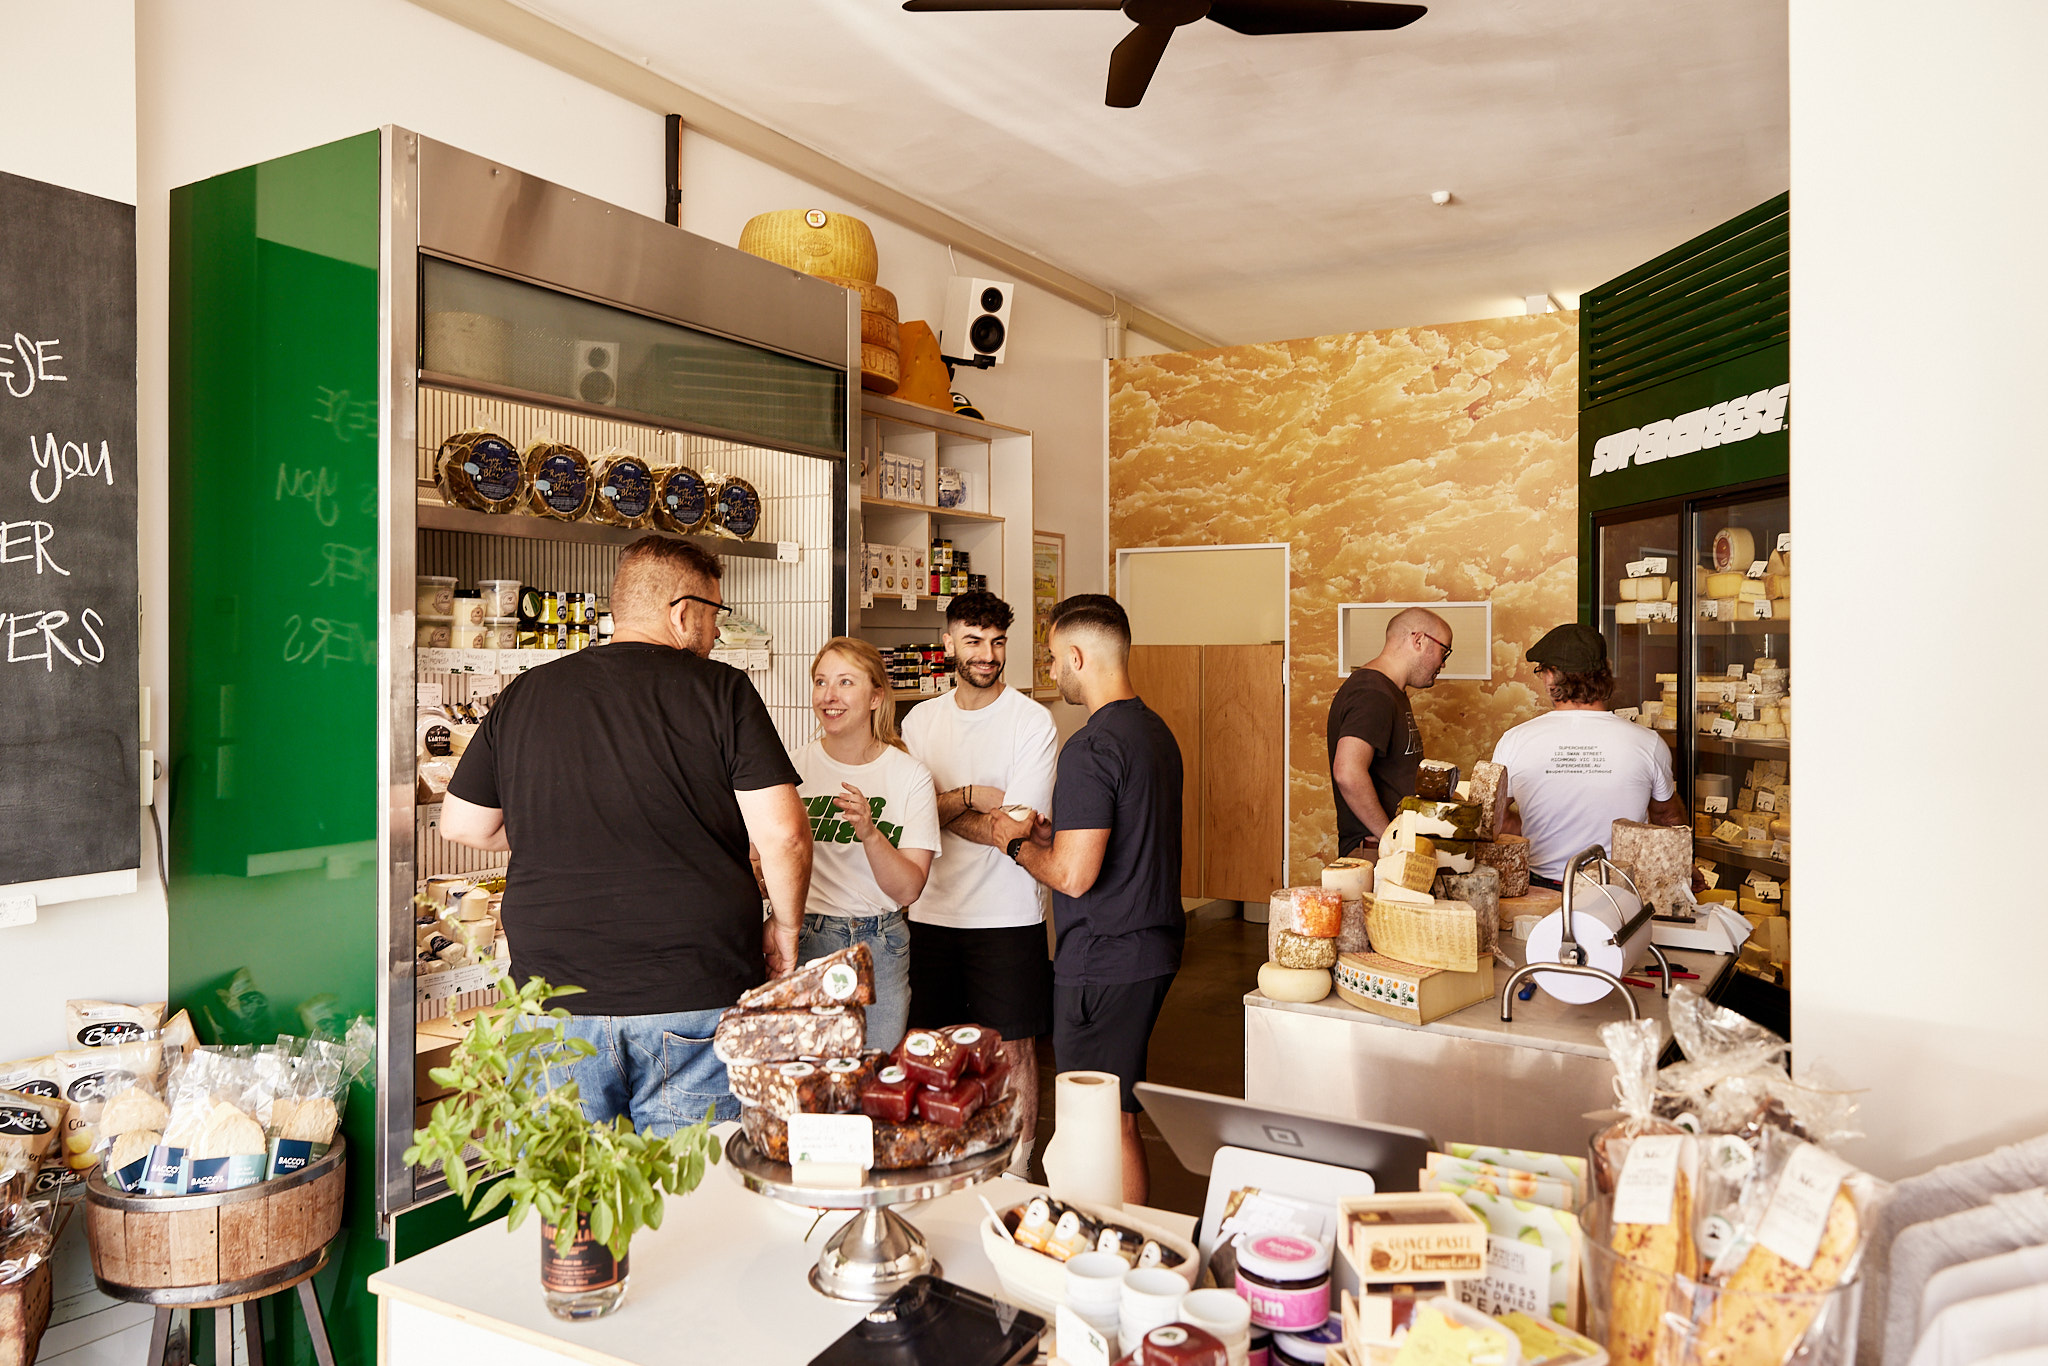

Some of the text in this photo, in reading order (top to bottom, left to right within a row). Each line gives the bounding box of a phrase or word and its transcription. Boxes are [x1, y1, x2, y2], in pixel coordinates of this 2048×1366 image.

[1437, 1235, 1472, 1249] PASTE
[1461, 1281, 1536, 1311] SUN DRIED
[1461, 1292, 1517, 1316] PEA
